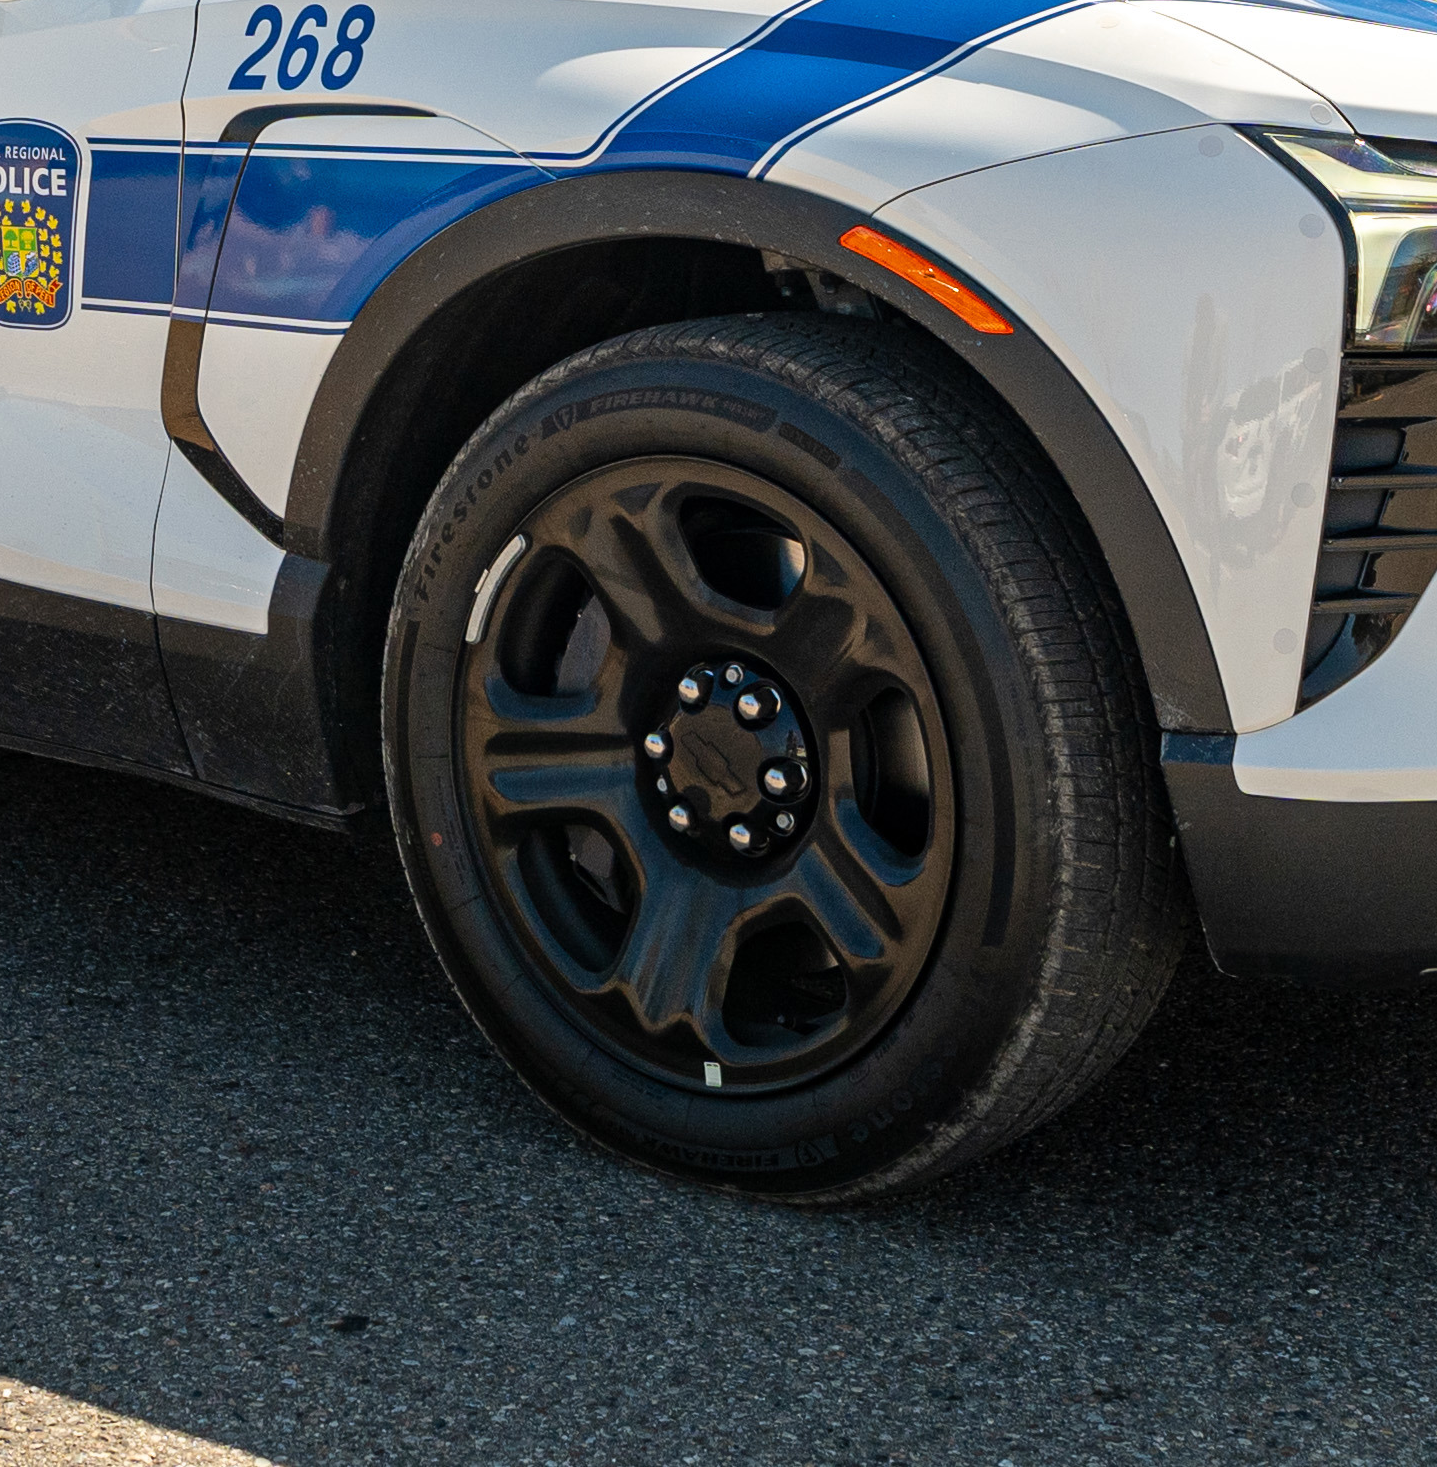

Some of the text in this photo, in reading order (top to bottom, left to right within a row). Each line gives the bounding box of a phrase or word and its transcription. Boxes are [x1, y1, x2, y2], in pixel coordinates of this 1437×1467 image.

[227, 3, 376, 91] 268
[4, 145, 66, 161] REGIONAL
[26, 281, 36, 290] OF
[35, 285, 53, 306] PEEL
[590, 390, 720, 415] FIREHAWK
